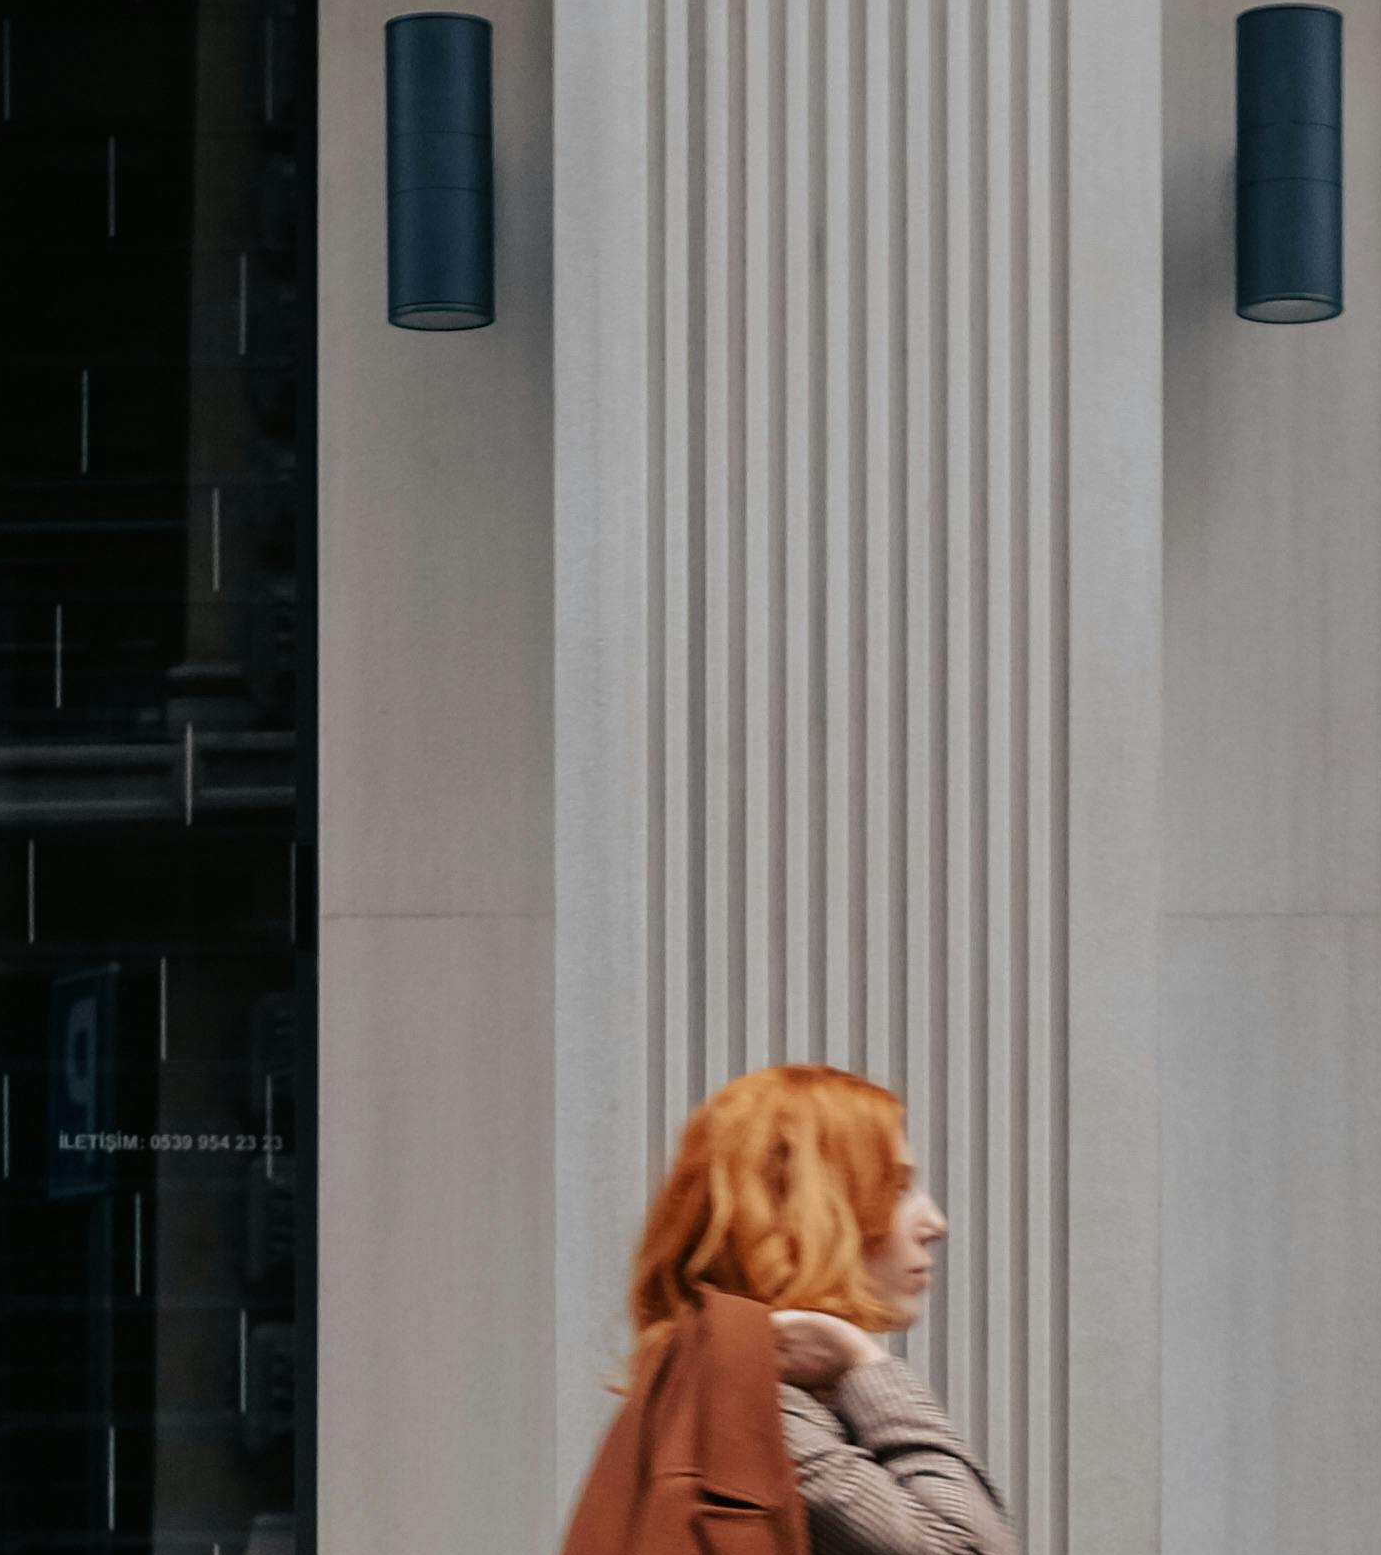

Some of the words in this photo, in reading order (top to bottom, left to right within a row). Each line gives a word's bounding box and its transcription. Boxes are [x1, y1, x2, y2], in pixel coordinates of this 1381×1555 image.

[58, 1129, 146, 1153] İLETİŞİM:
[149, 1133, 193, 1151] 0539
[197, 1133, 231, 1151] 954
[235, 1133, 257, 1151] 23
[261, 1133, 284, 1151] 23
